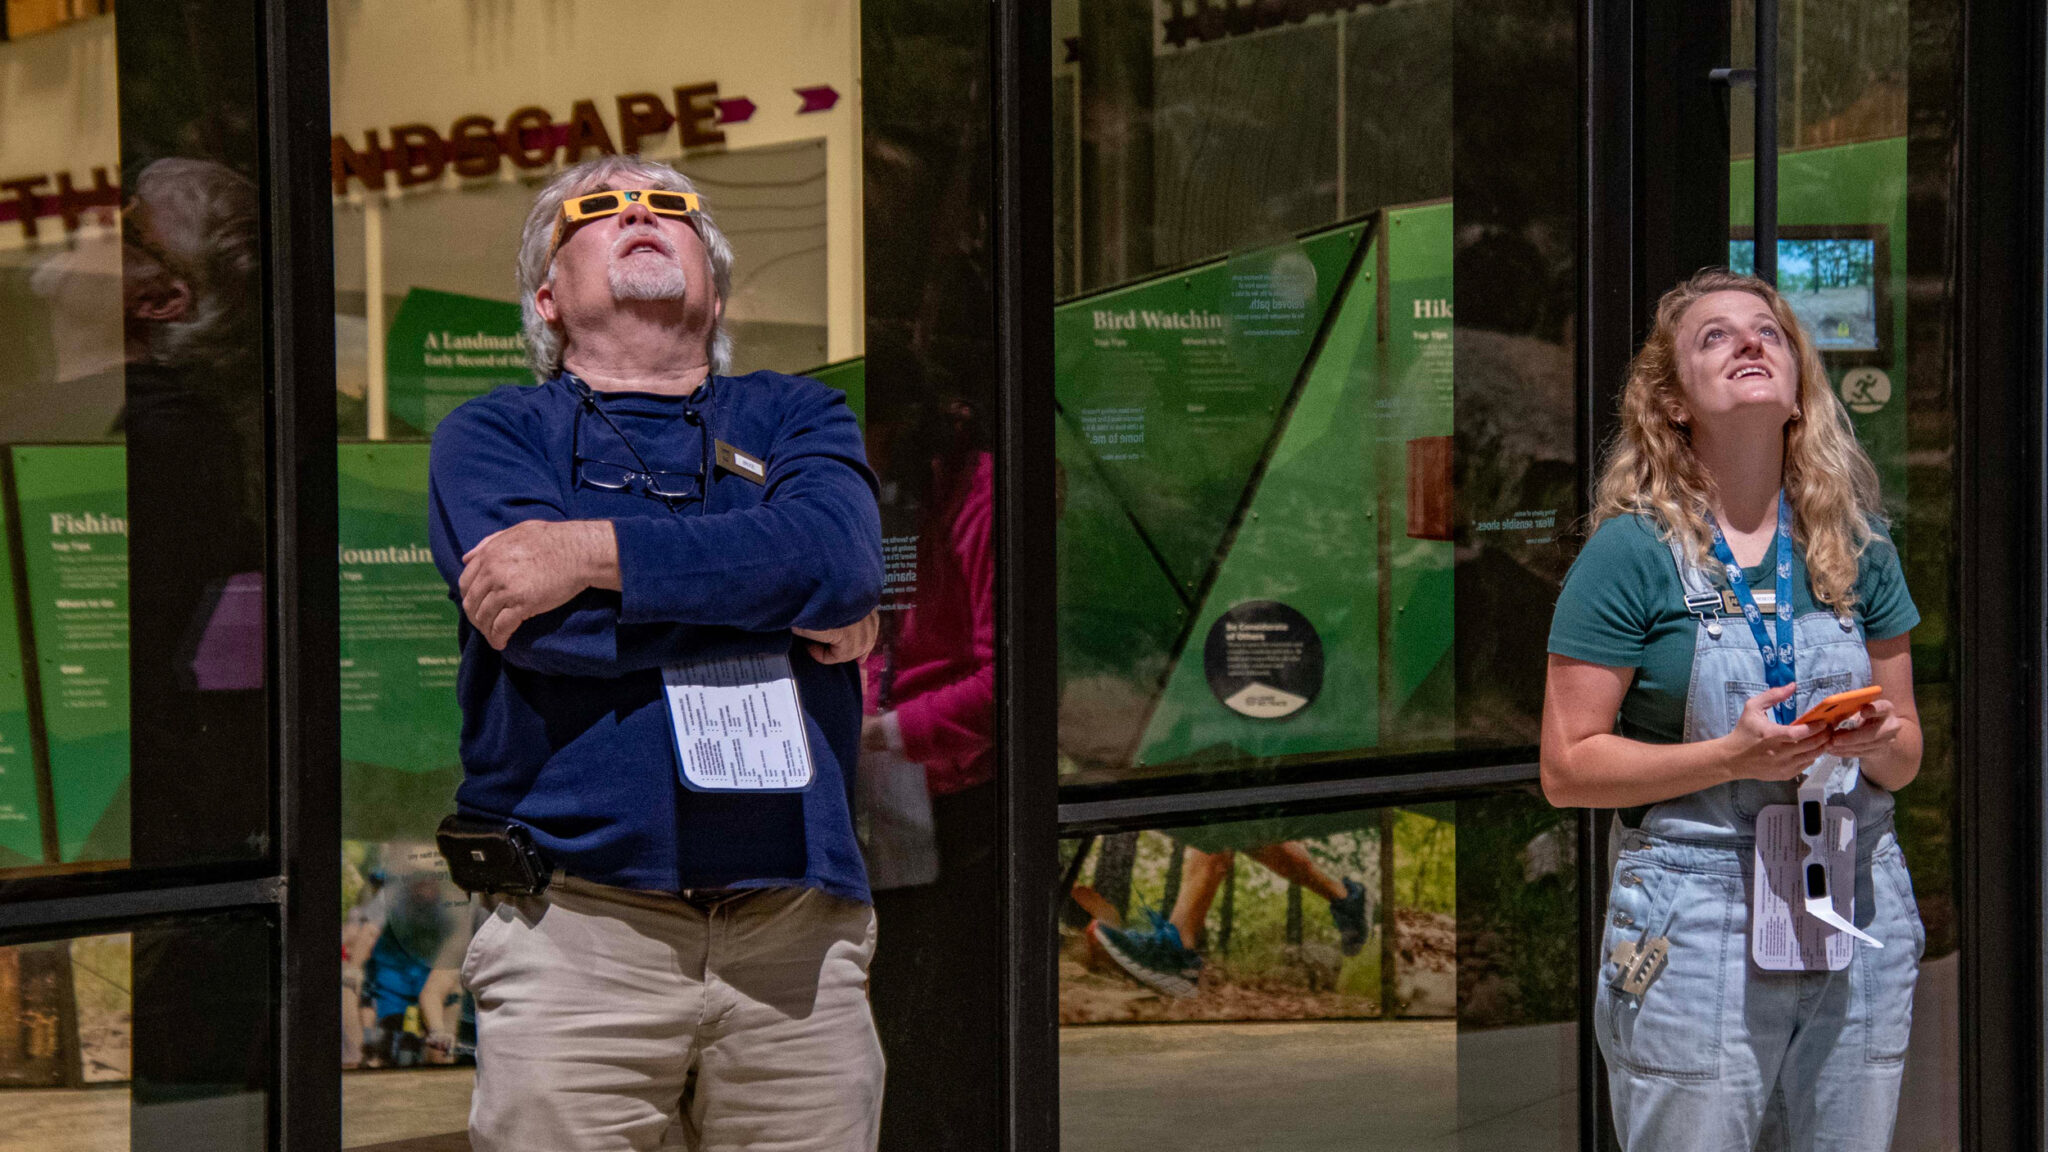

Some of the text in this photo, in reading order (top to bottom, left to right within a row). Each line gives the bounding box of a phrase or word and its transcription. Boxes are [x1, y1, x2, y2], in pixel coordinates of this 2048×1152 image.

[0, 165, 121, 238] TH
[1093, 310, 1136, 330] Bird
[424, 331, 525, 350] A Landmark
[424, 354, 452, 367] Early
[456, 354, 495, 367] Record
[497, 355, 508, 366] of
[417, 656, 446, 666] Where
